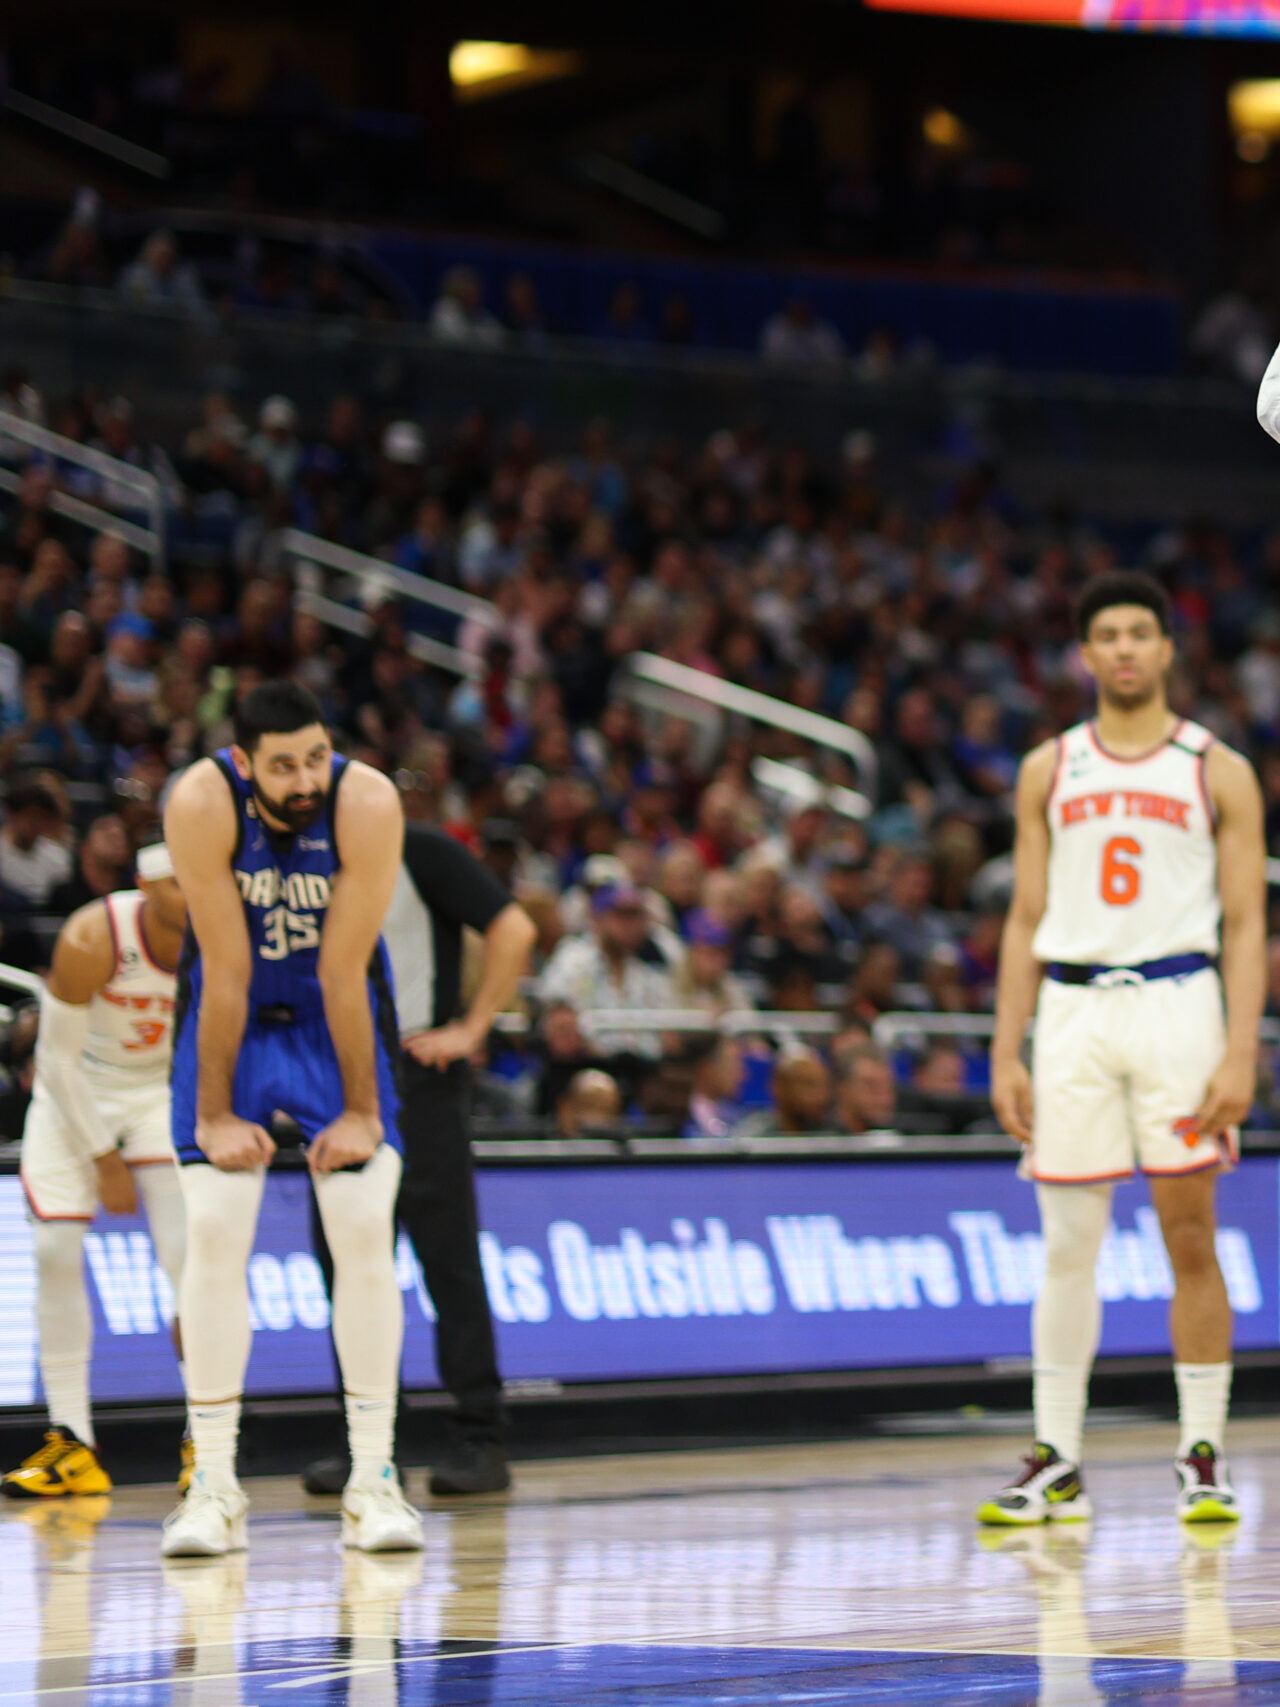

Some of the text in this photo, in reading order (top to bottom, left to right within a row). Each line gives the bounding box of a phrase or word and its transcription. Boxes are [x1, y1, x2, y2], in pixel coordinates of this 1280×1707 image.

[1102, 835, 1141, 906] 6
[259, 905, 320, 961] 35
[548, 1218, 775, 1321] Outside
